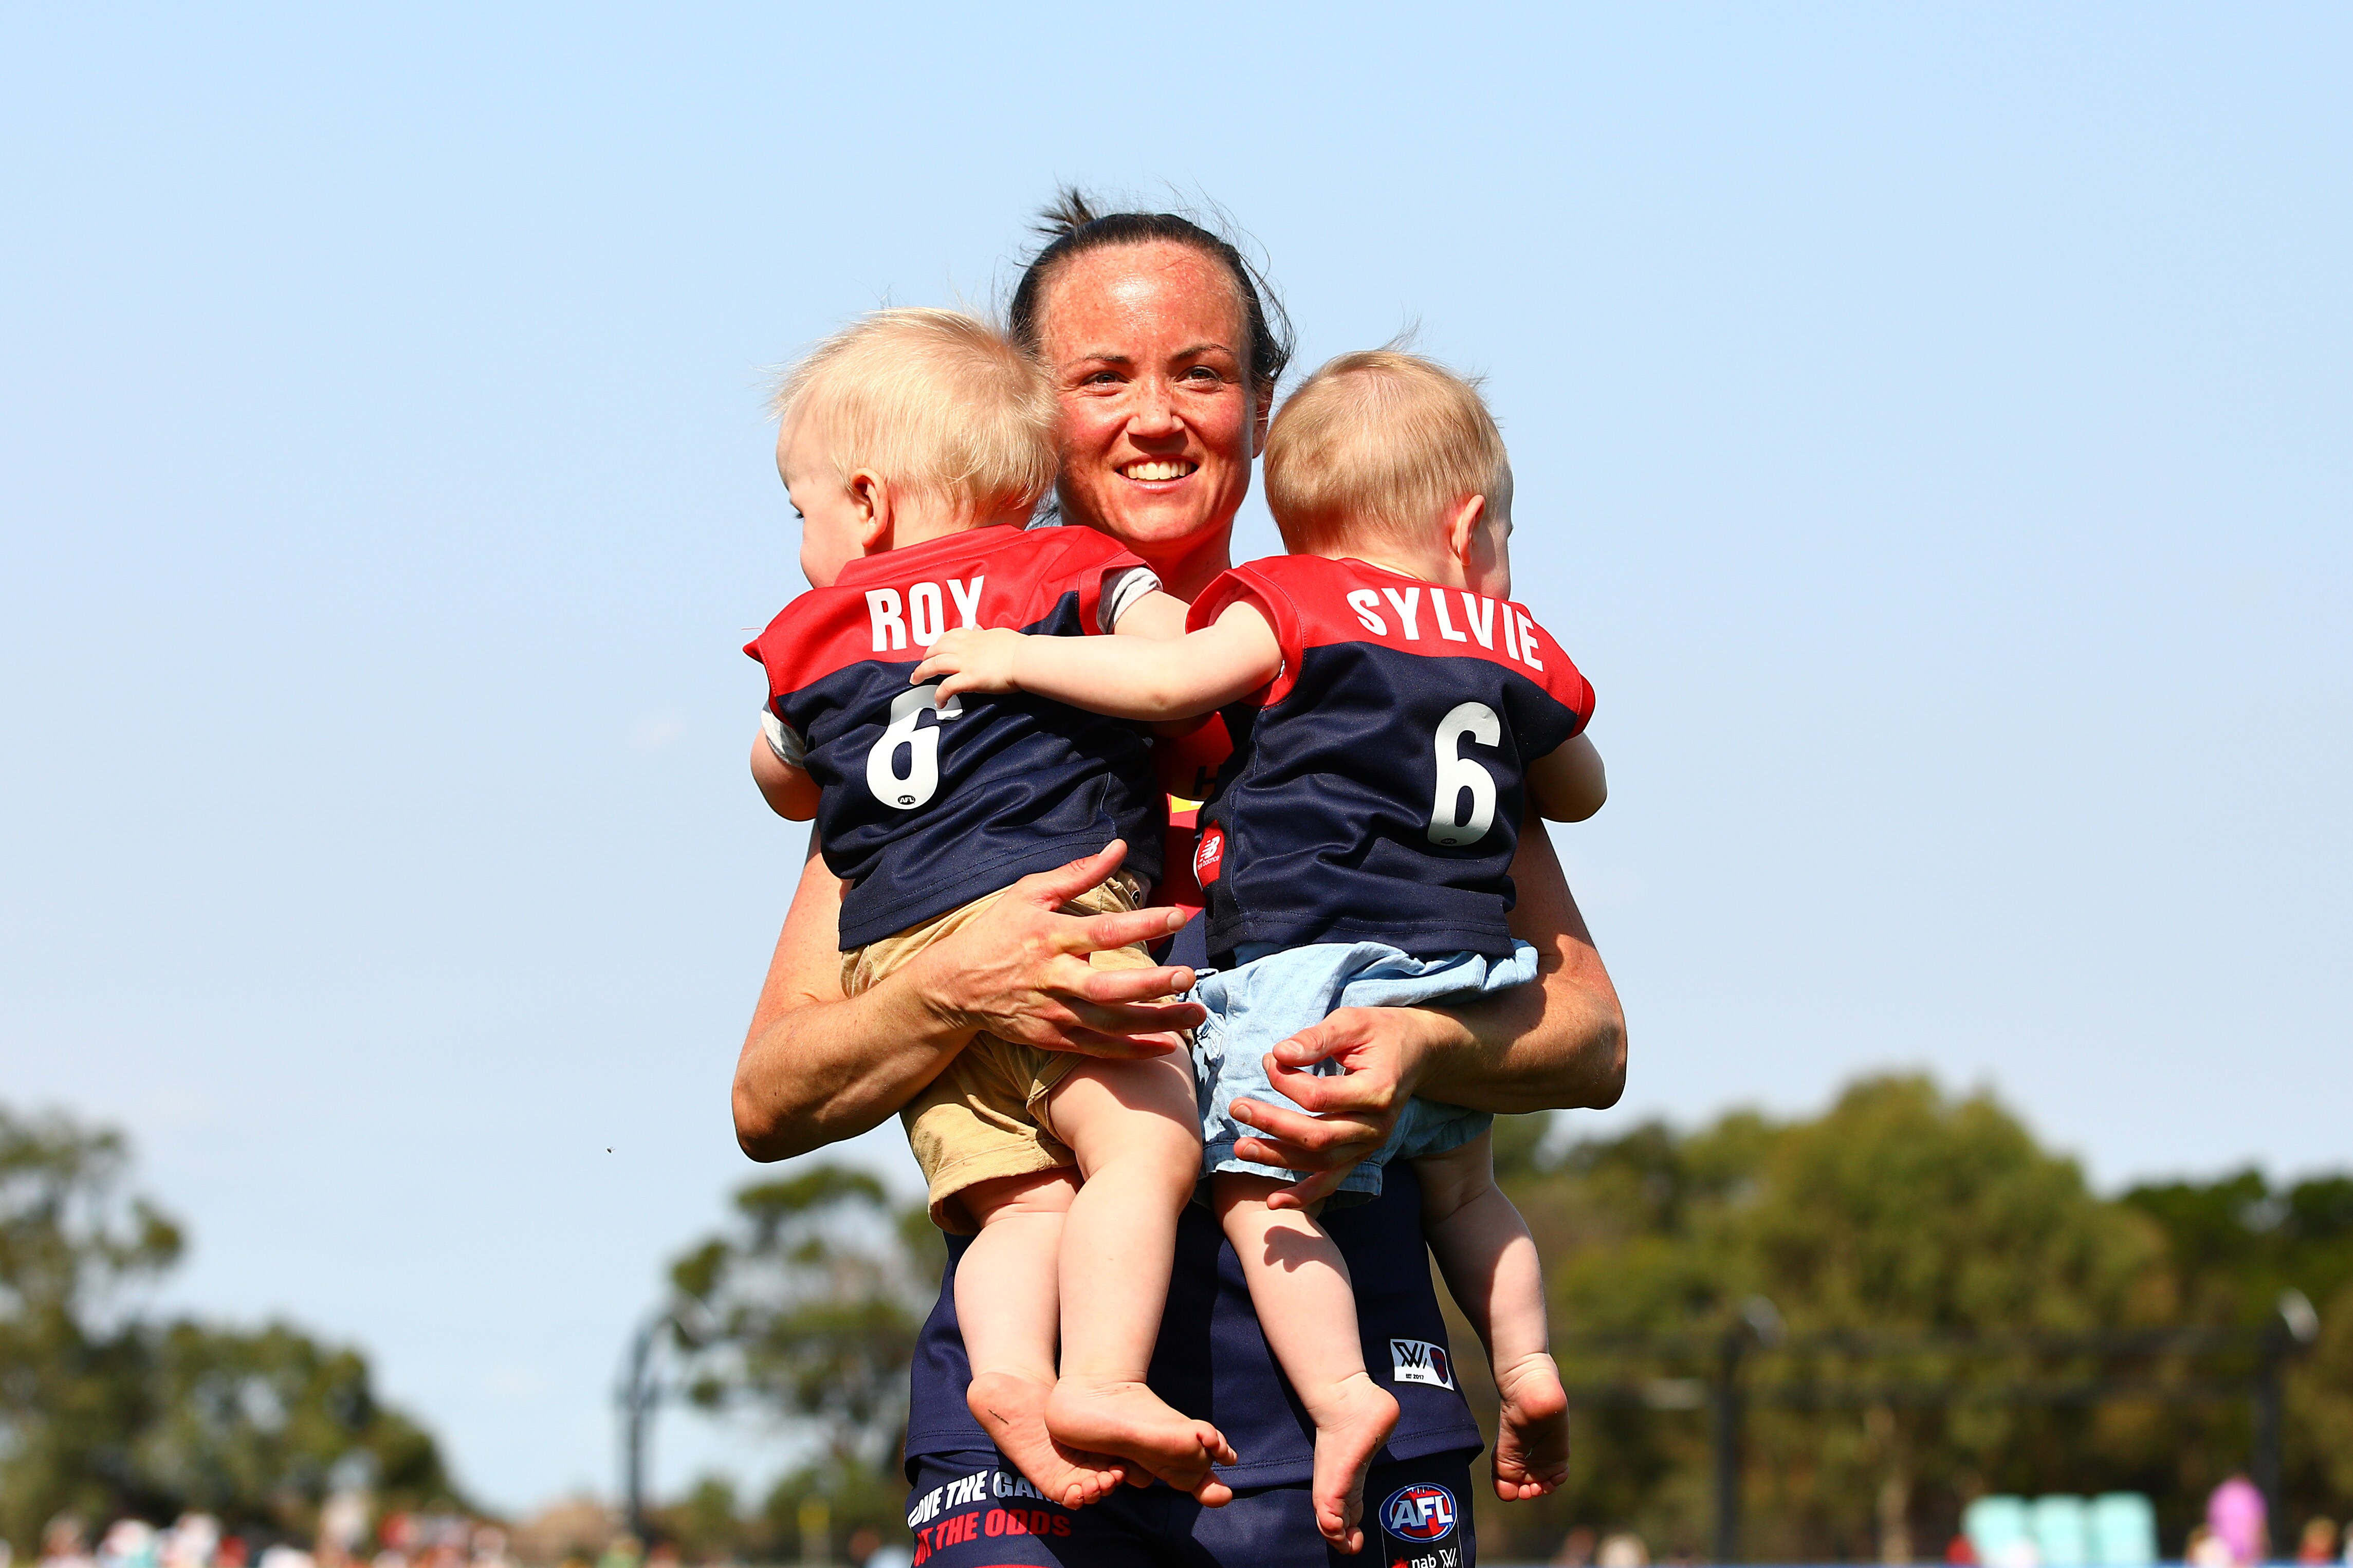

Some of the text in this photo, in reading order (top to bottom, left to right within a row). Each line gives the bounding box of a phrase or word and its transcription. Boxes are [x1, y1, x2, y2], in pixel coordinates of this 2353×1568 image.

[865, 575, 984, 652] ROY
[1346, 587, 1543, 672] SYLVIE
[866, 685, 963, 809] 6
[1427, 702, 1501, 846] 6
[1203, 855, 1220, 867] balance
[945, 1470, 988, 1510] THE
[993, 1471, 1061, 1505] GA
[935, 1511, 980, 1551] THE
[984, 1508, 1071, 1537] ODDS
[1391, 1495, 1454, 1529] AFL
[1411, 1554, 1437, 1568] nab
